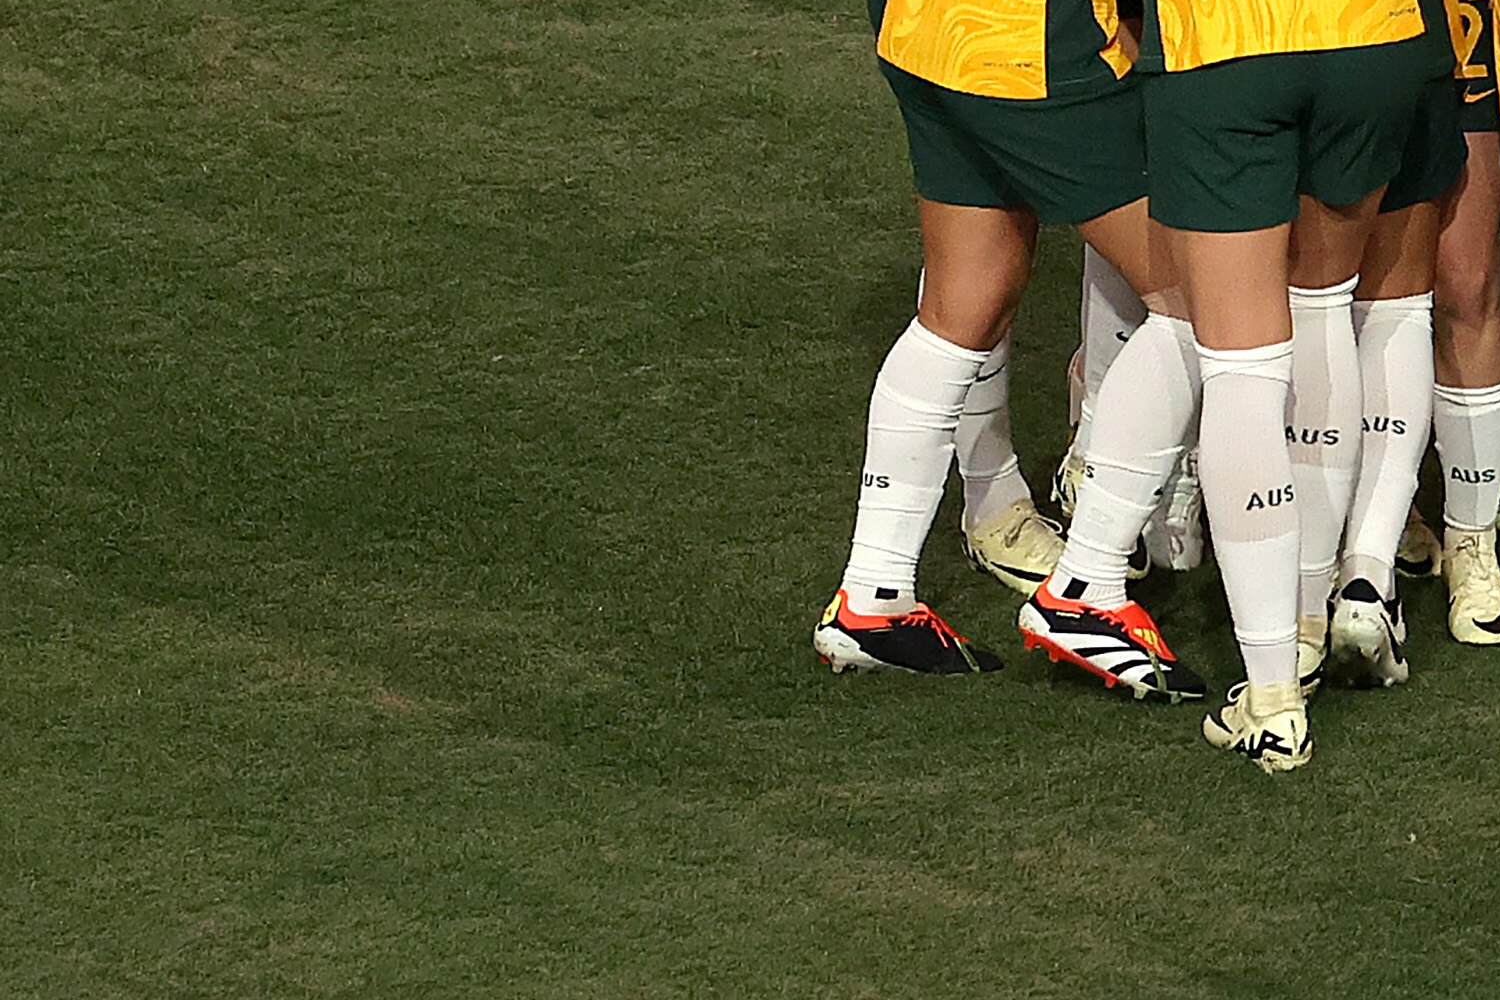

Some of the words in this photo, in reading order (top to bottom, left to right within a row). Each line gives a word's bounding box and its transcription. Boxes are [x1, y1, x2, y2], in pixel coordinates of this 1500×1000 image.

[1285, 425, 1340, 445] AUS
[1451, 466, 1496, 484] AUS
[1246, 484, 1294, 511] AUS
